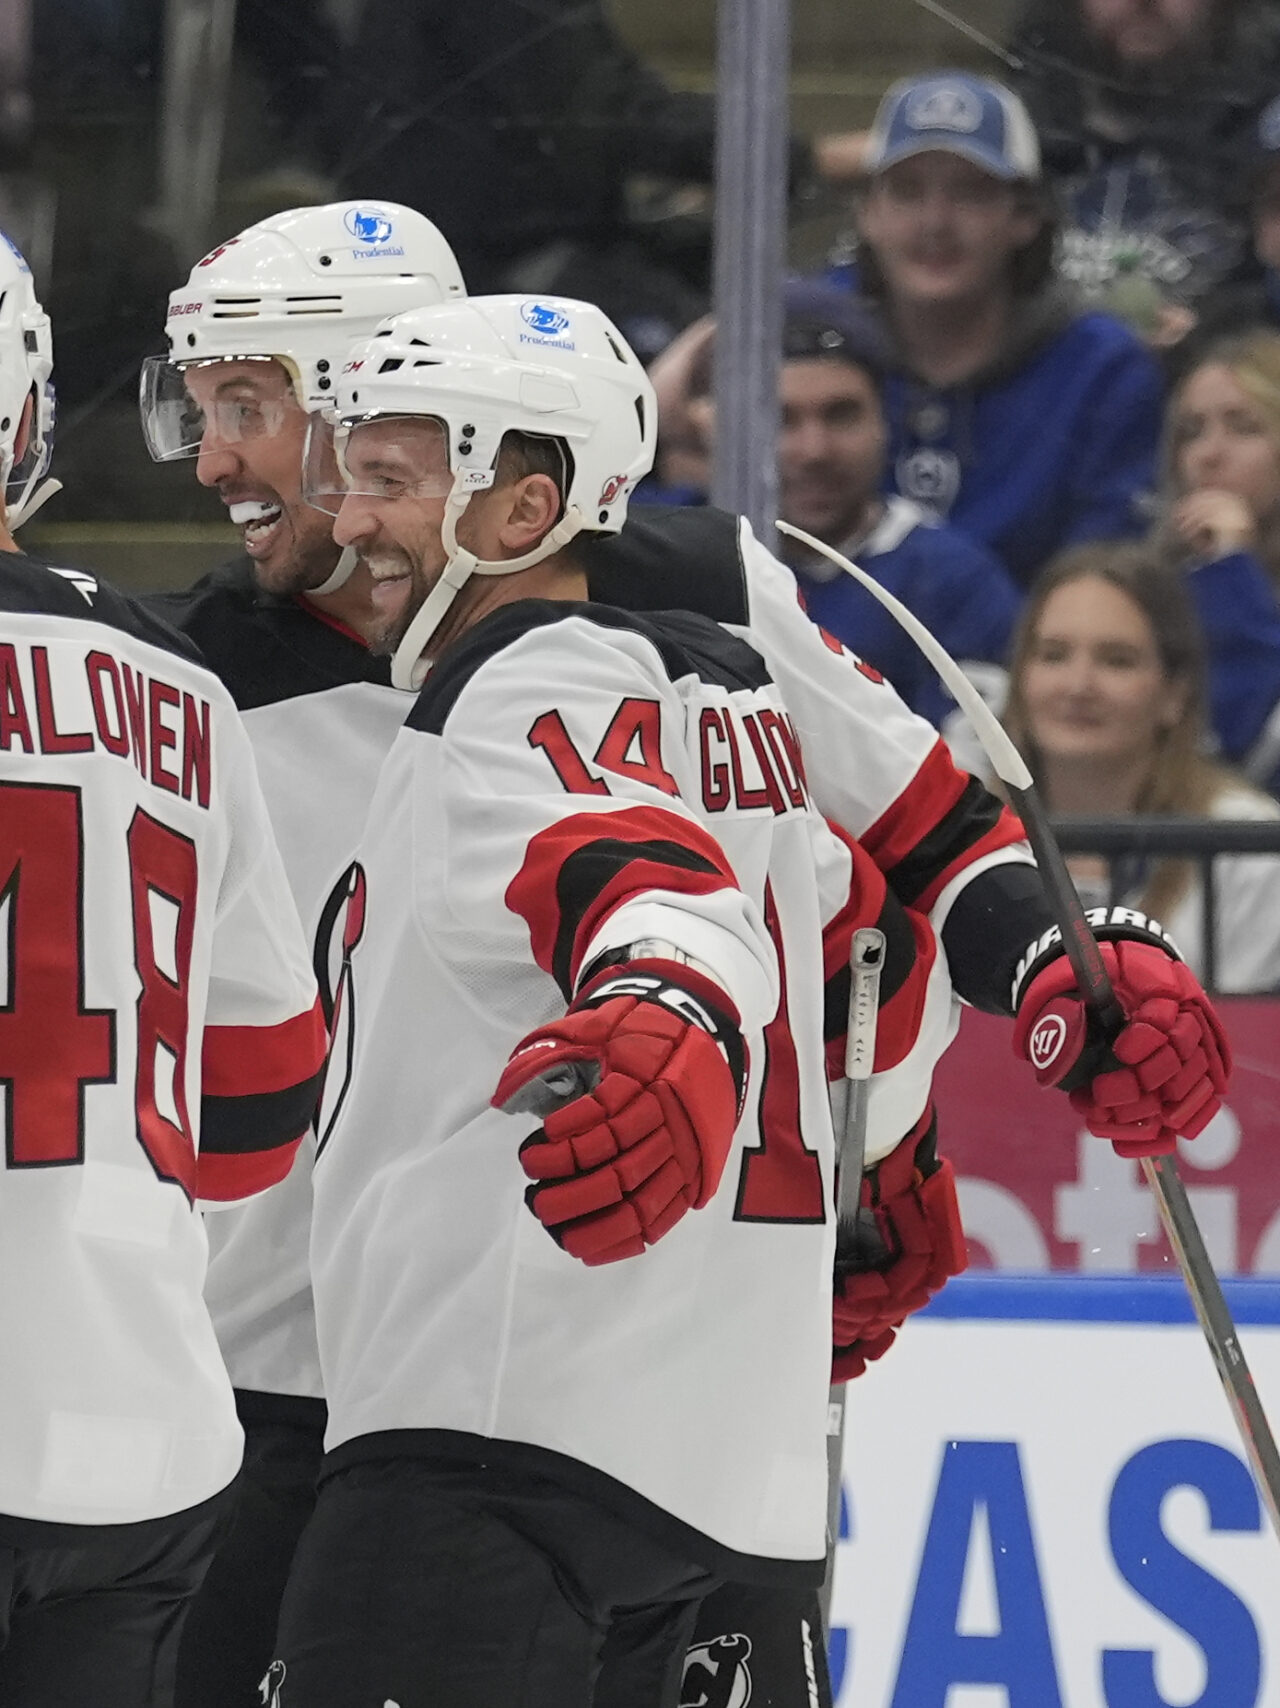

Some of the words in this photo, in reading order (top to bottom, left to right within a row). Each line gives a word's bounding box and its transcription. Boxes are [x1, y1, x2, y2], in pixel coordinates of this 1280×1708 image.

[352, 246, 405, 259] Prudential
[519, 333, 576, 351] Prudential
[526, 696, 683, 800] 14
